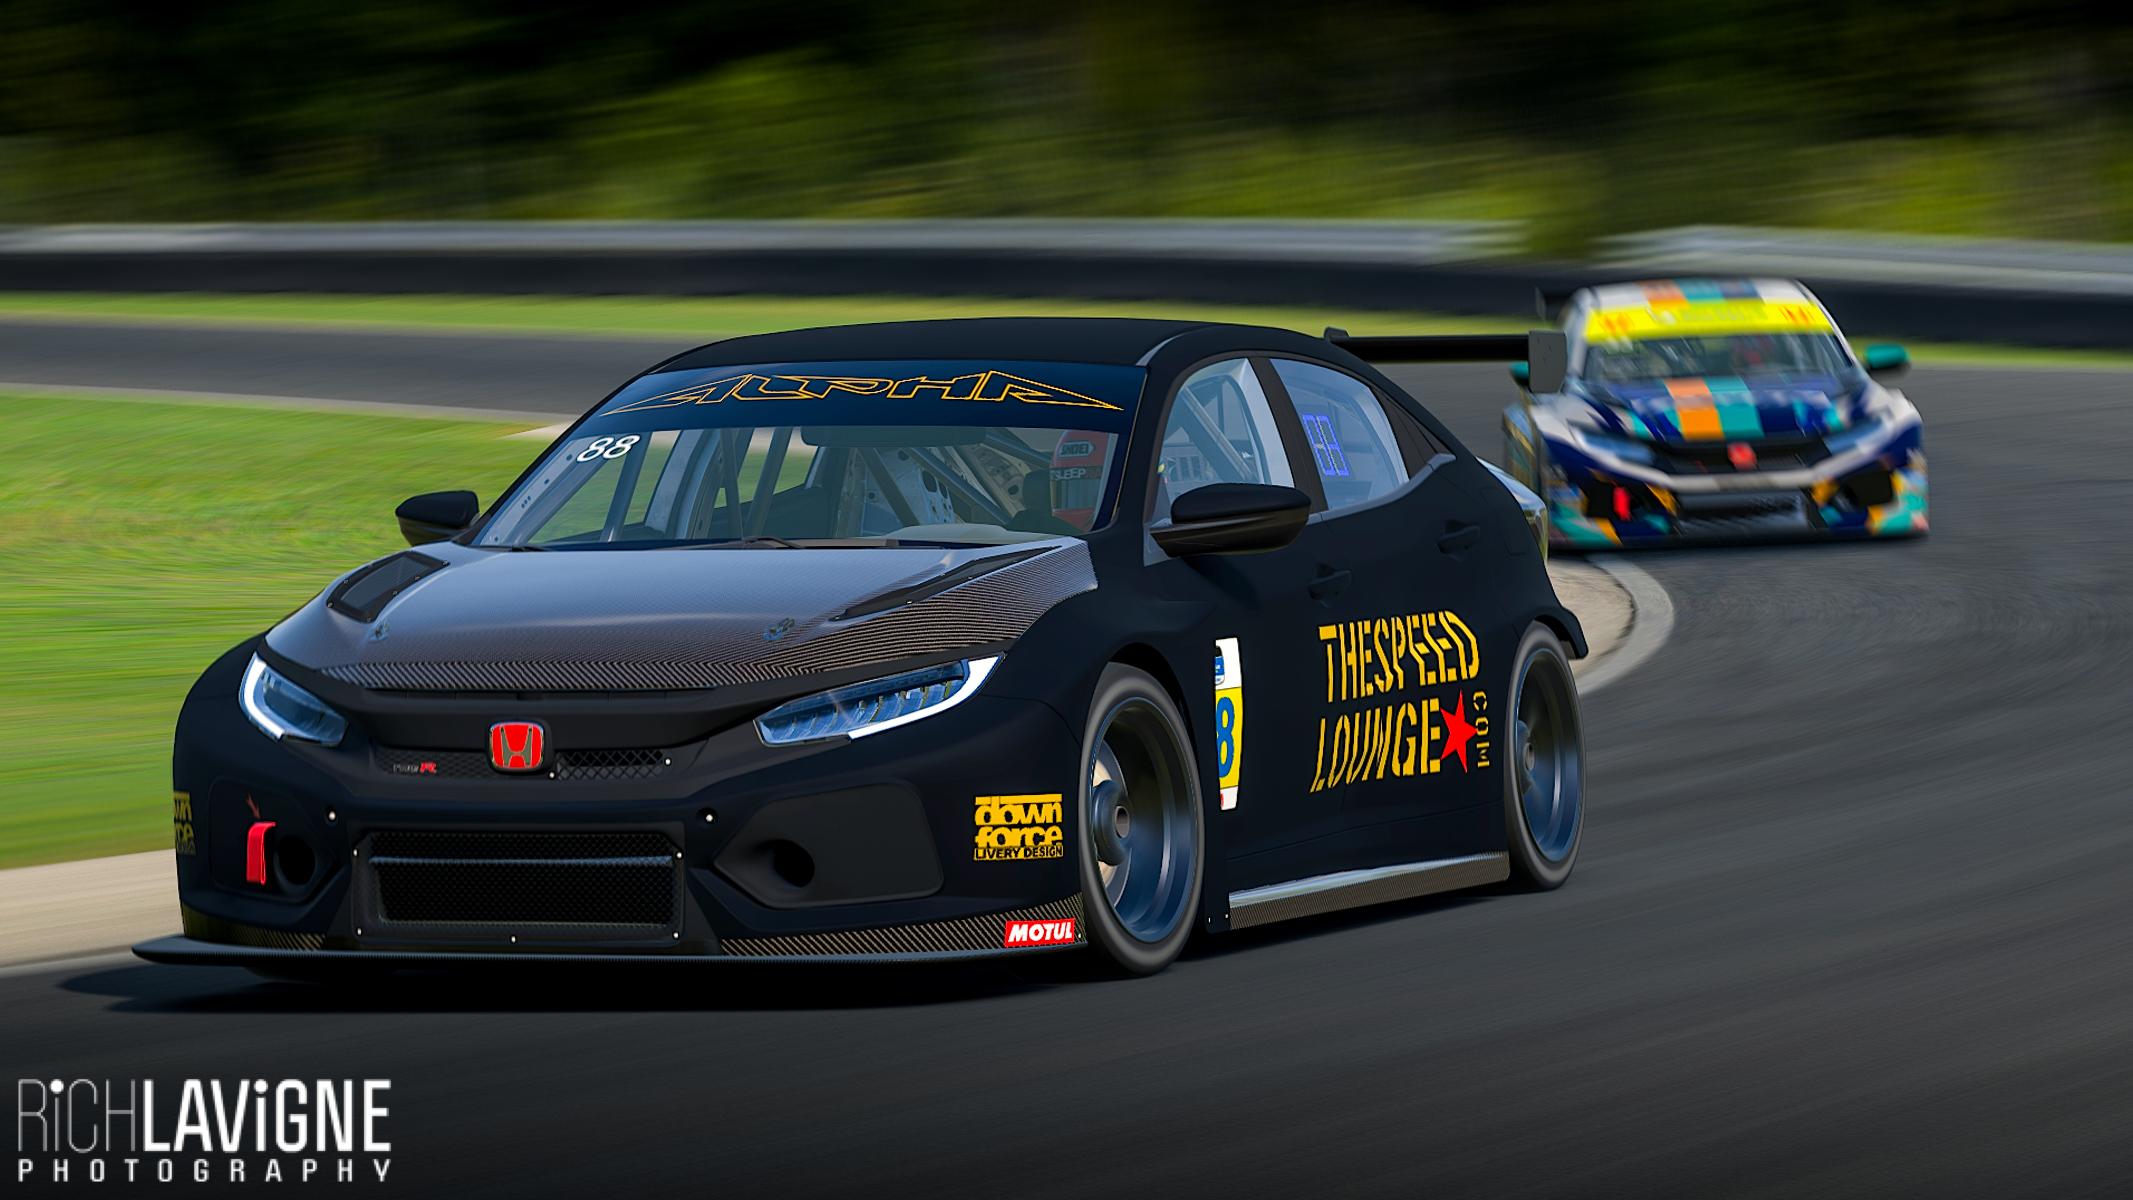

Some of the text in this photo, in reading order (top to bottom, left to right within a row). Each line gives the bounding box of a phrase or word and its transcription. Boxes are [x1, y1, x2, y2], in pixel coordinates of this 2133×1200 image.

[599, 370, 1124, 416] ALPHA
[577, 434, 640, 462] 88
[1309, 698, 1441, 793] LOUNGE
[975, 825, 1063, 849] force
[976, 846, 1063, 859] LIVERY DESIGN
[1008, 922, 1073, 942] MOTUL
